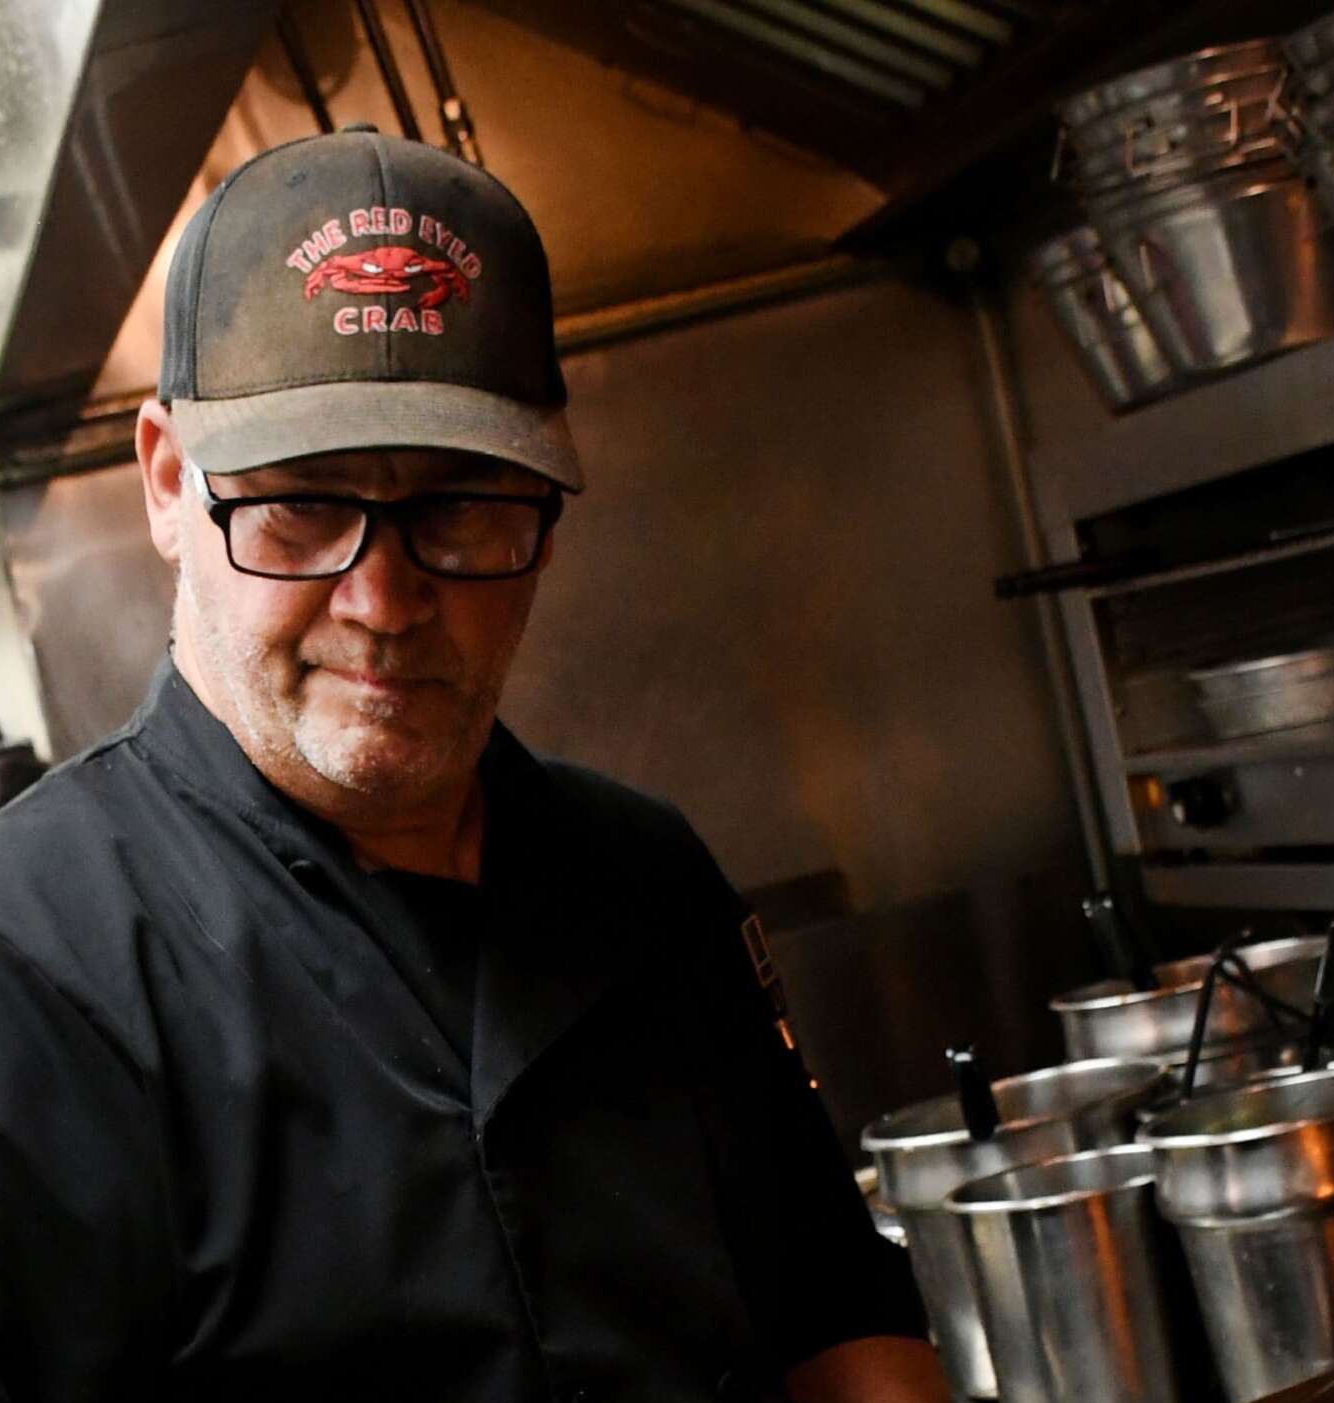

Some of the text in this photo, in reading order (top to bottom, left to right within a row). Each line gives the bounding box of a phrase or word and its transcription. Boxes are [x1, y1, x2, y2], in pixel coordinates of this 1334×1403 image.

[286, 206, 483, 279] THE RED EYED
[333, 304, 444, 336] CRAB
